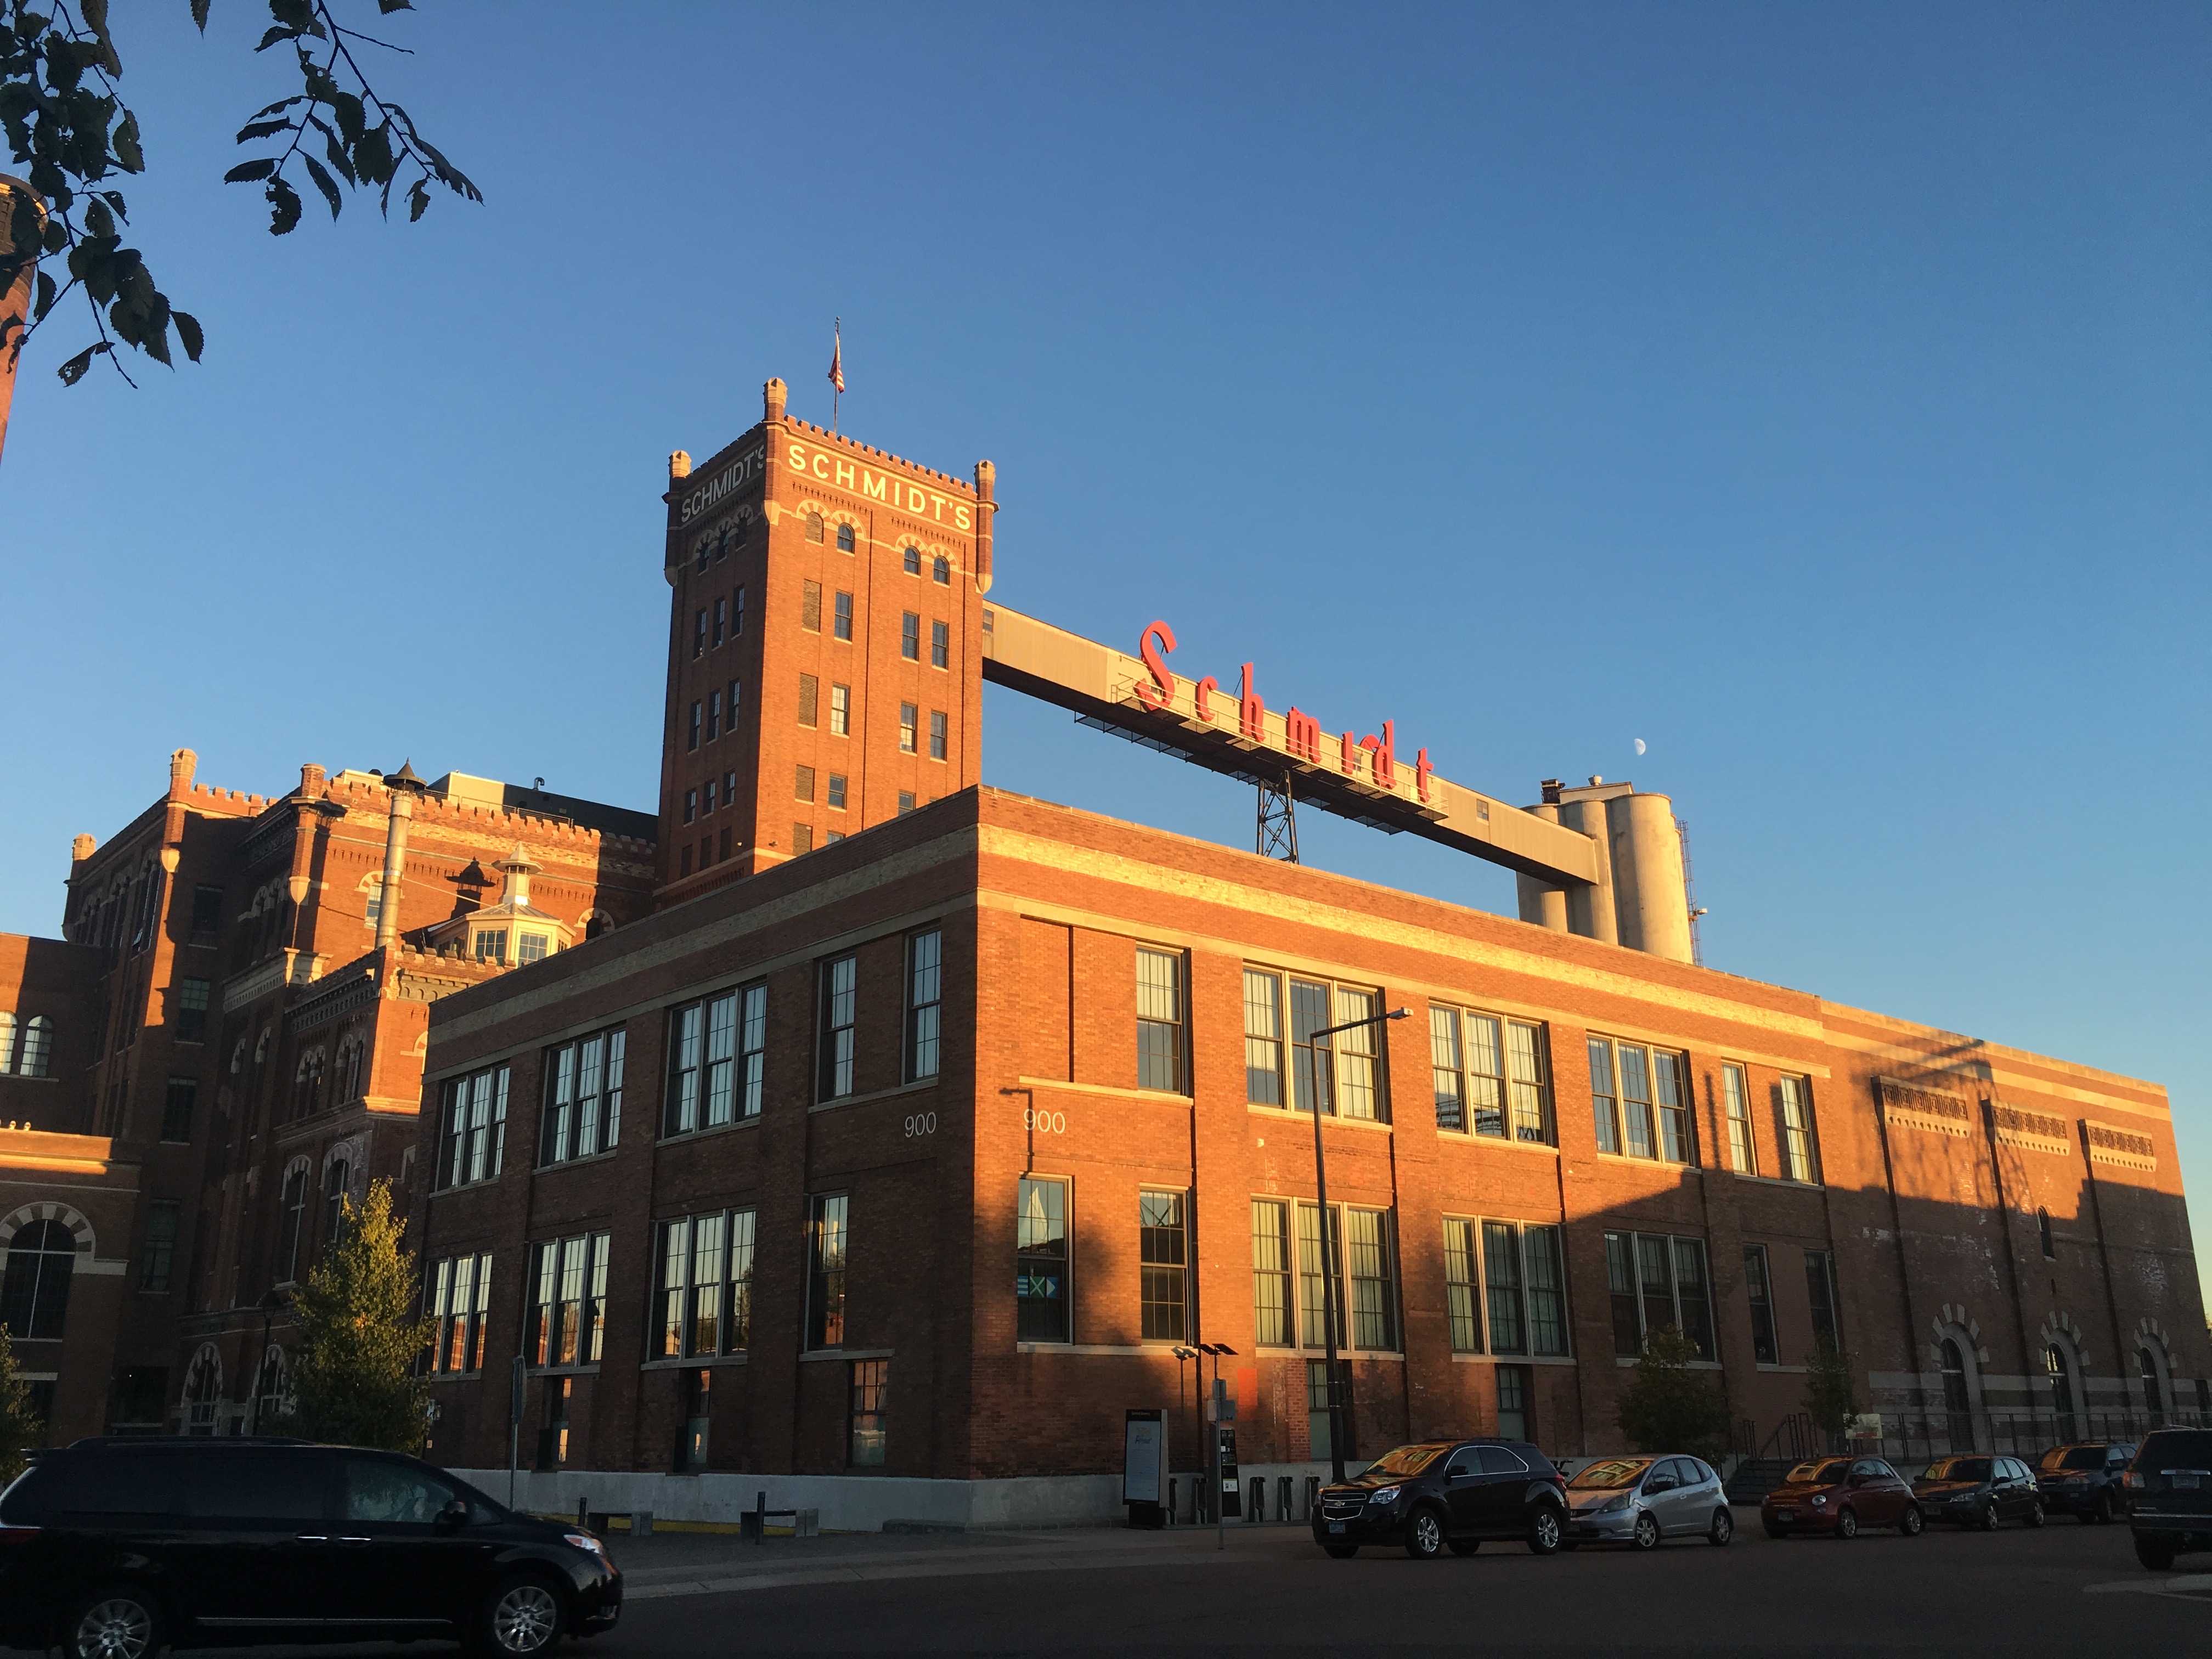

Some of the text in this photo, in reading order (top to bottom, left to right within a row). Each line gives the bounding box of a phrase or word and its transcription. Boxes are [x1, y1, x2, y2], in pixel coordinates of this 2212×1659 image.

[788, 444, 970, 530] SCHMIDT'S
[1134, 620, 1434, 804] Schmidt
[905, 1111, 936, 1137] 900
[1024, 1108, 1065, 1134] 900
